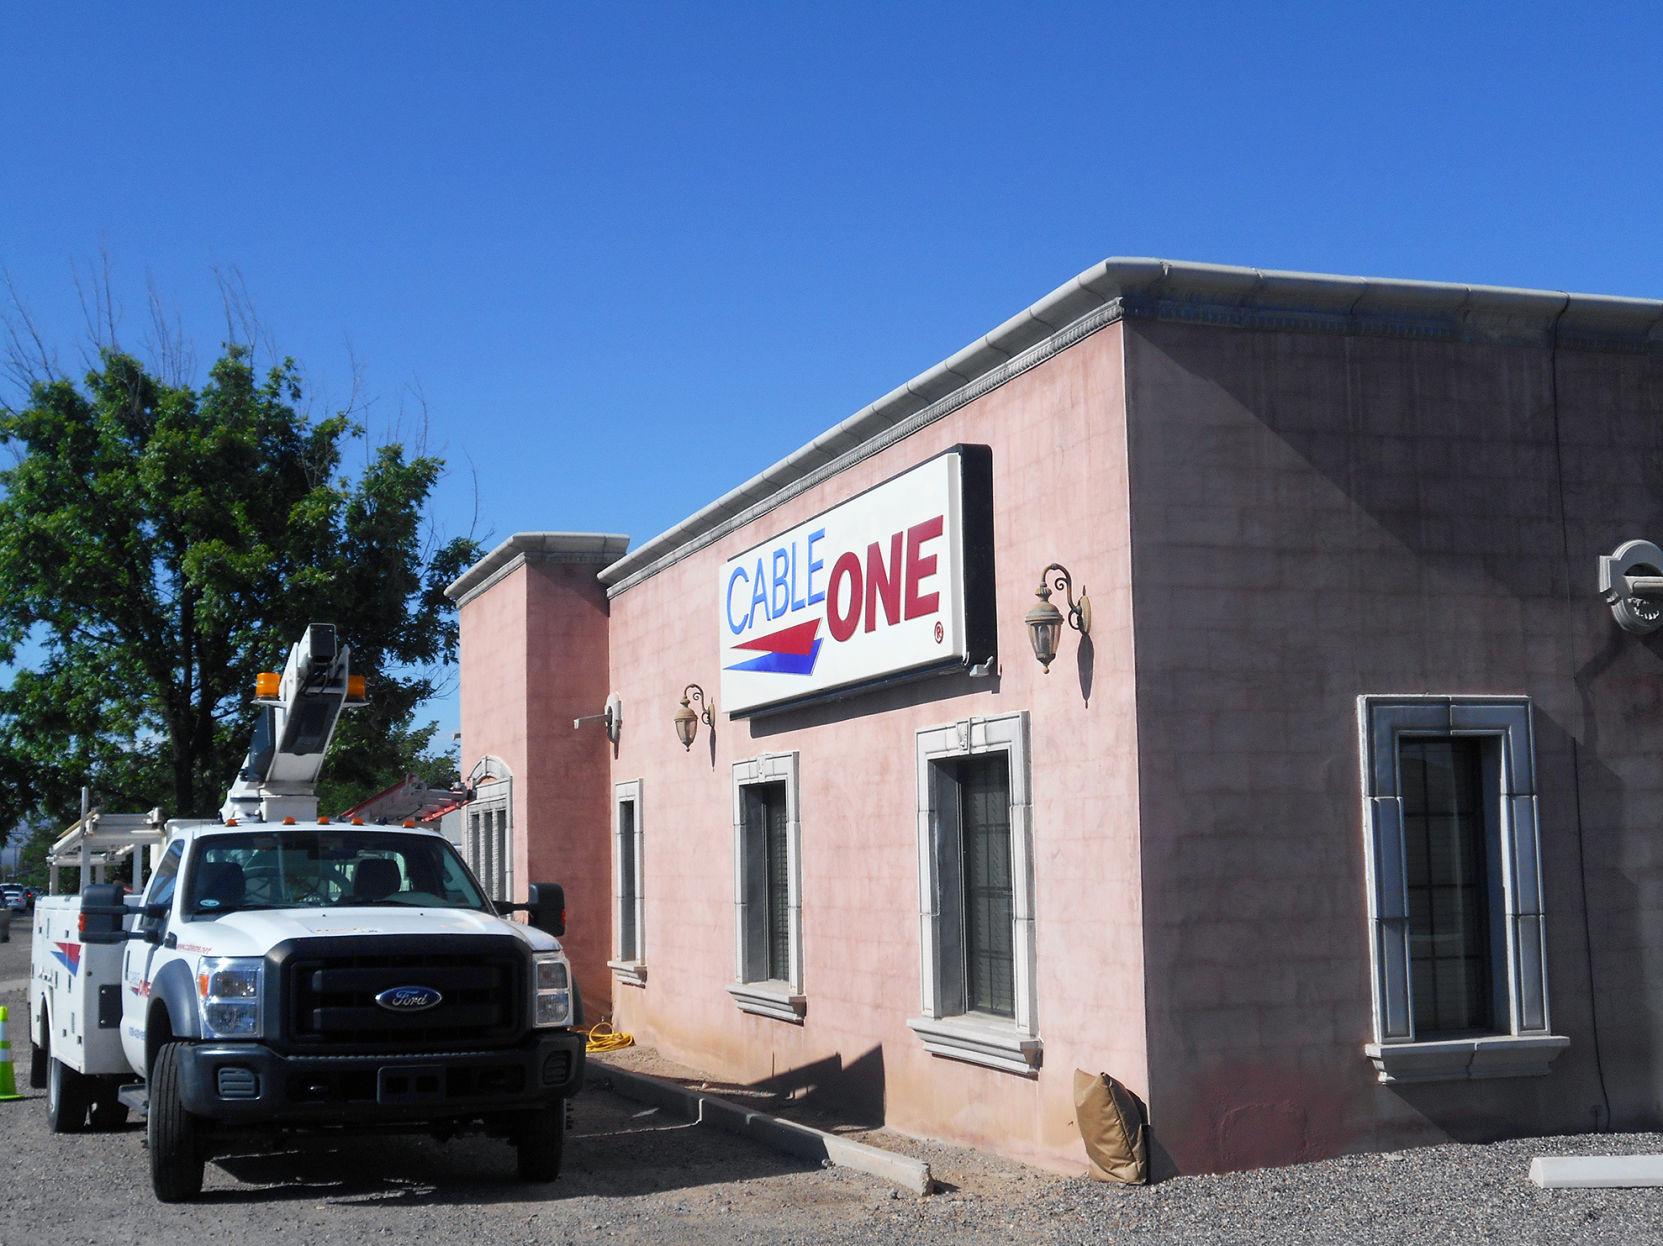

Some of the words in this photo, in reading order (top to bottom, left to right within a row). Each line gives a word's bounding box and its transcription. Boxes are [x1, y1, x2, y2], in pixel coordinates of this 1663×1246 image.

[727, 528, 826, 635] CABLE
[827, 515, 944, 642] ONE
[392, 990, 428, 1006] Ford
